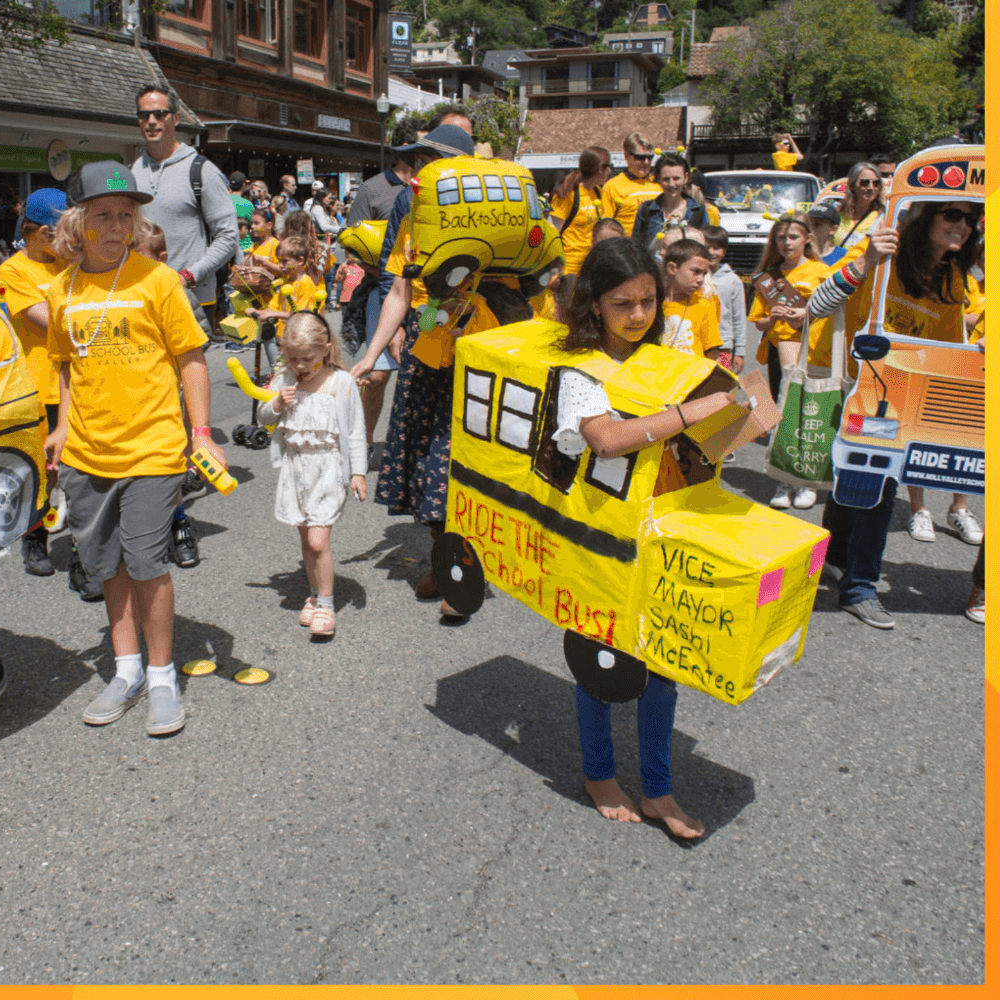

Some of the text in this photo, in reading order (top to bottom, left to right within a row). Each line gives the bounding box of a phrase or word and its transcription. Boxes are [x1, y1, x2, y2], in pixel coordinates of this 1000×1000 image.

[90, 343, 157, 358] SCHOOL BUS
[803, 419, 824, 430] EEP
[794, 428, 826, 444] CALM
[786, 446, 829, 462] CARRY
[909, 450, 985, 471] RIDE THE
[793, 462, 816, 475] ON
[455, 490, 560, 575] RIDE THE
[661, 542, 716, 587] VICE
[653, 575, 735, 638] MAYOR
